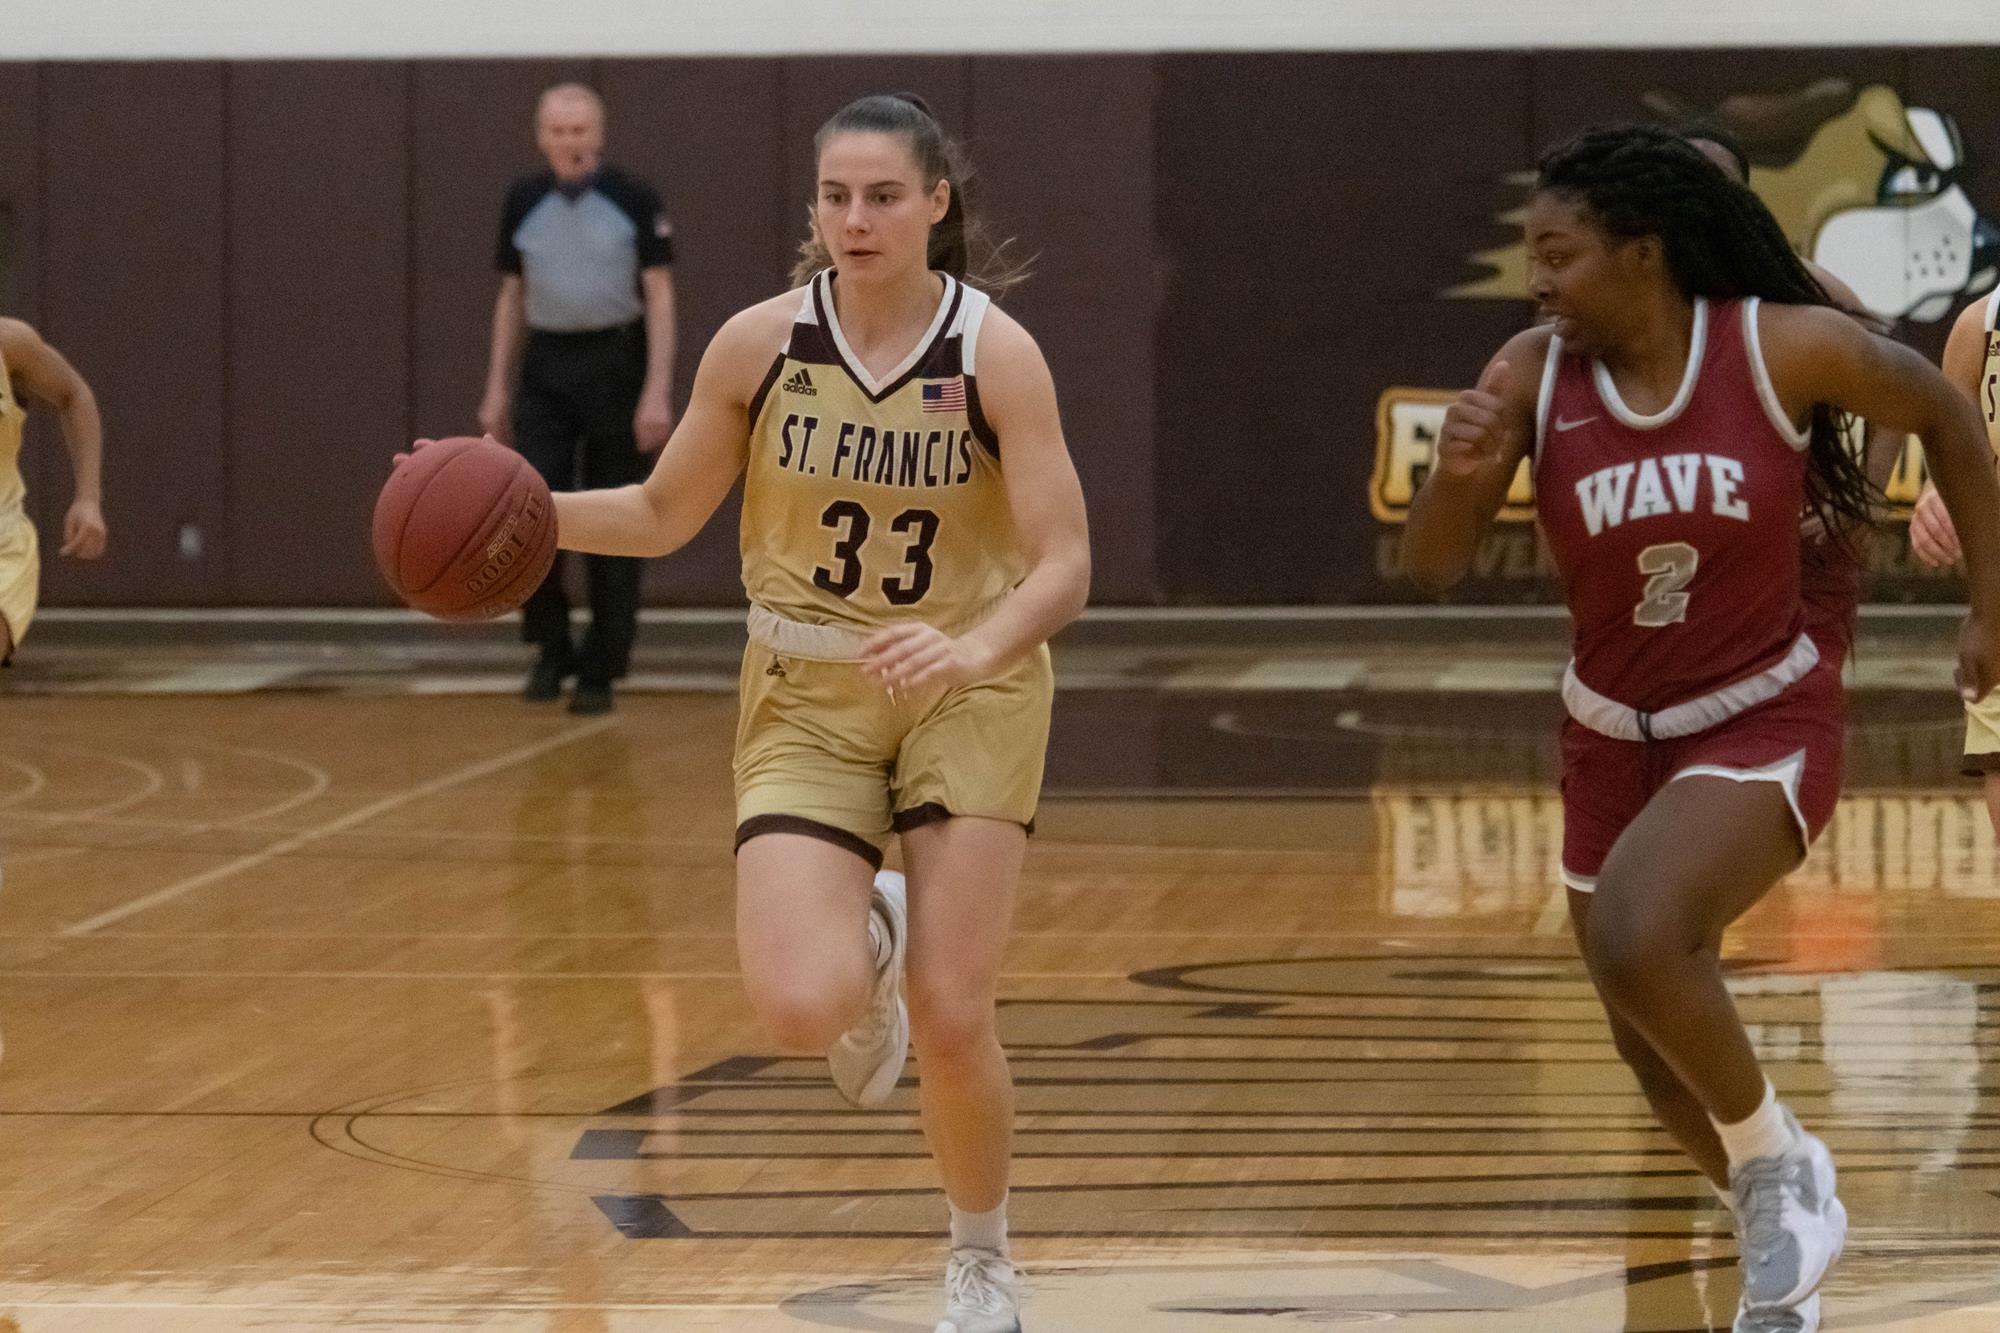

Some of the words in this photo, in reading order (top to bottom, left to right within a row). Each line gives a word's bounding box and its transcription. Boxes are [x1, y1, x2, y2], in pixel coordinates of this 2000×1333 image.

[782, 382, 817, 396] adidas
[779, 413, 819, 475] ST.
[832, 421, 972, 487] FRANCIS
[1575, 453, 1749, 537] WAVE
[813, 500, 940, 605] 33
[1633, 542, 1698, 627] 2
